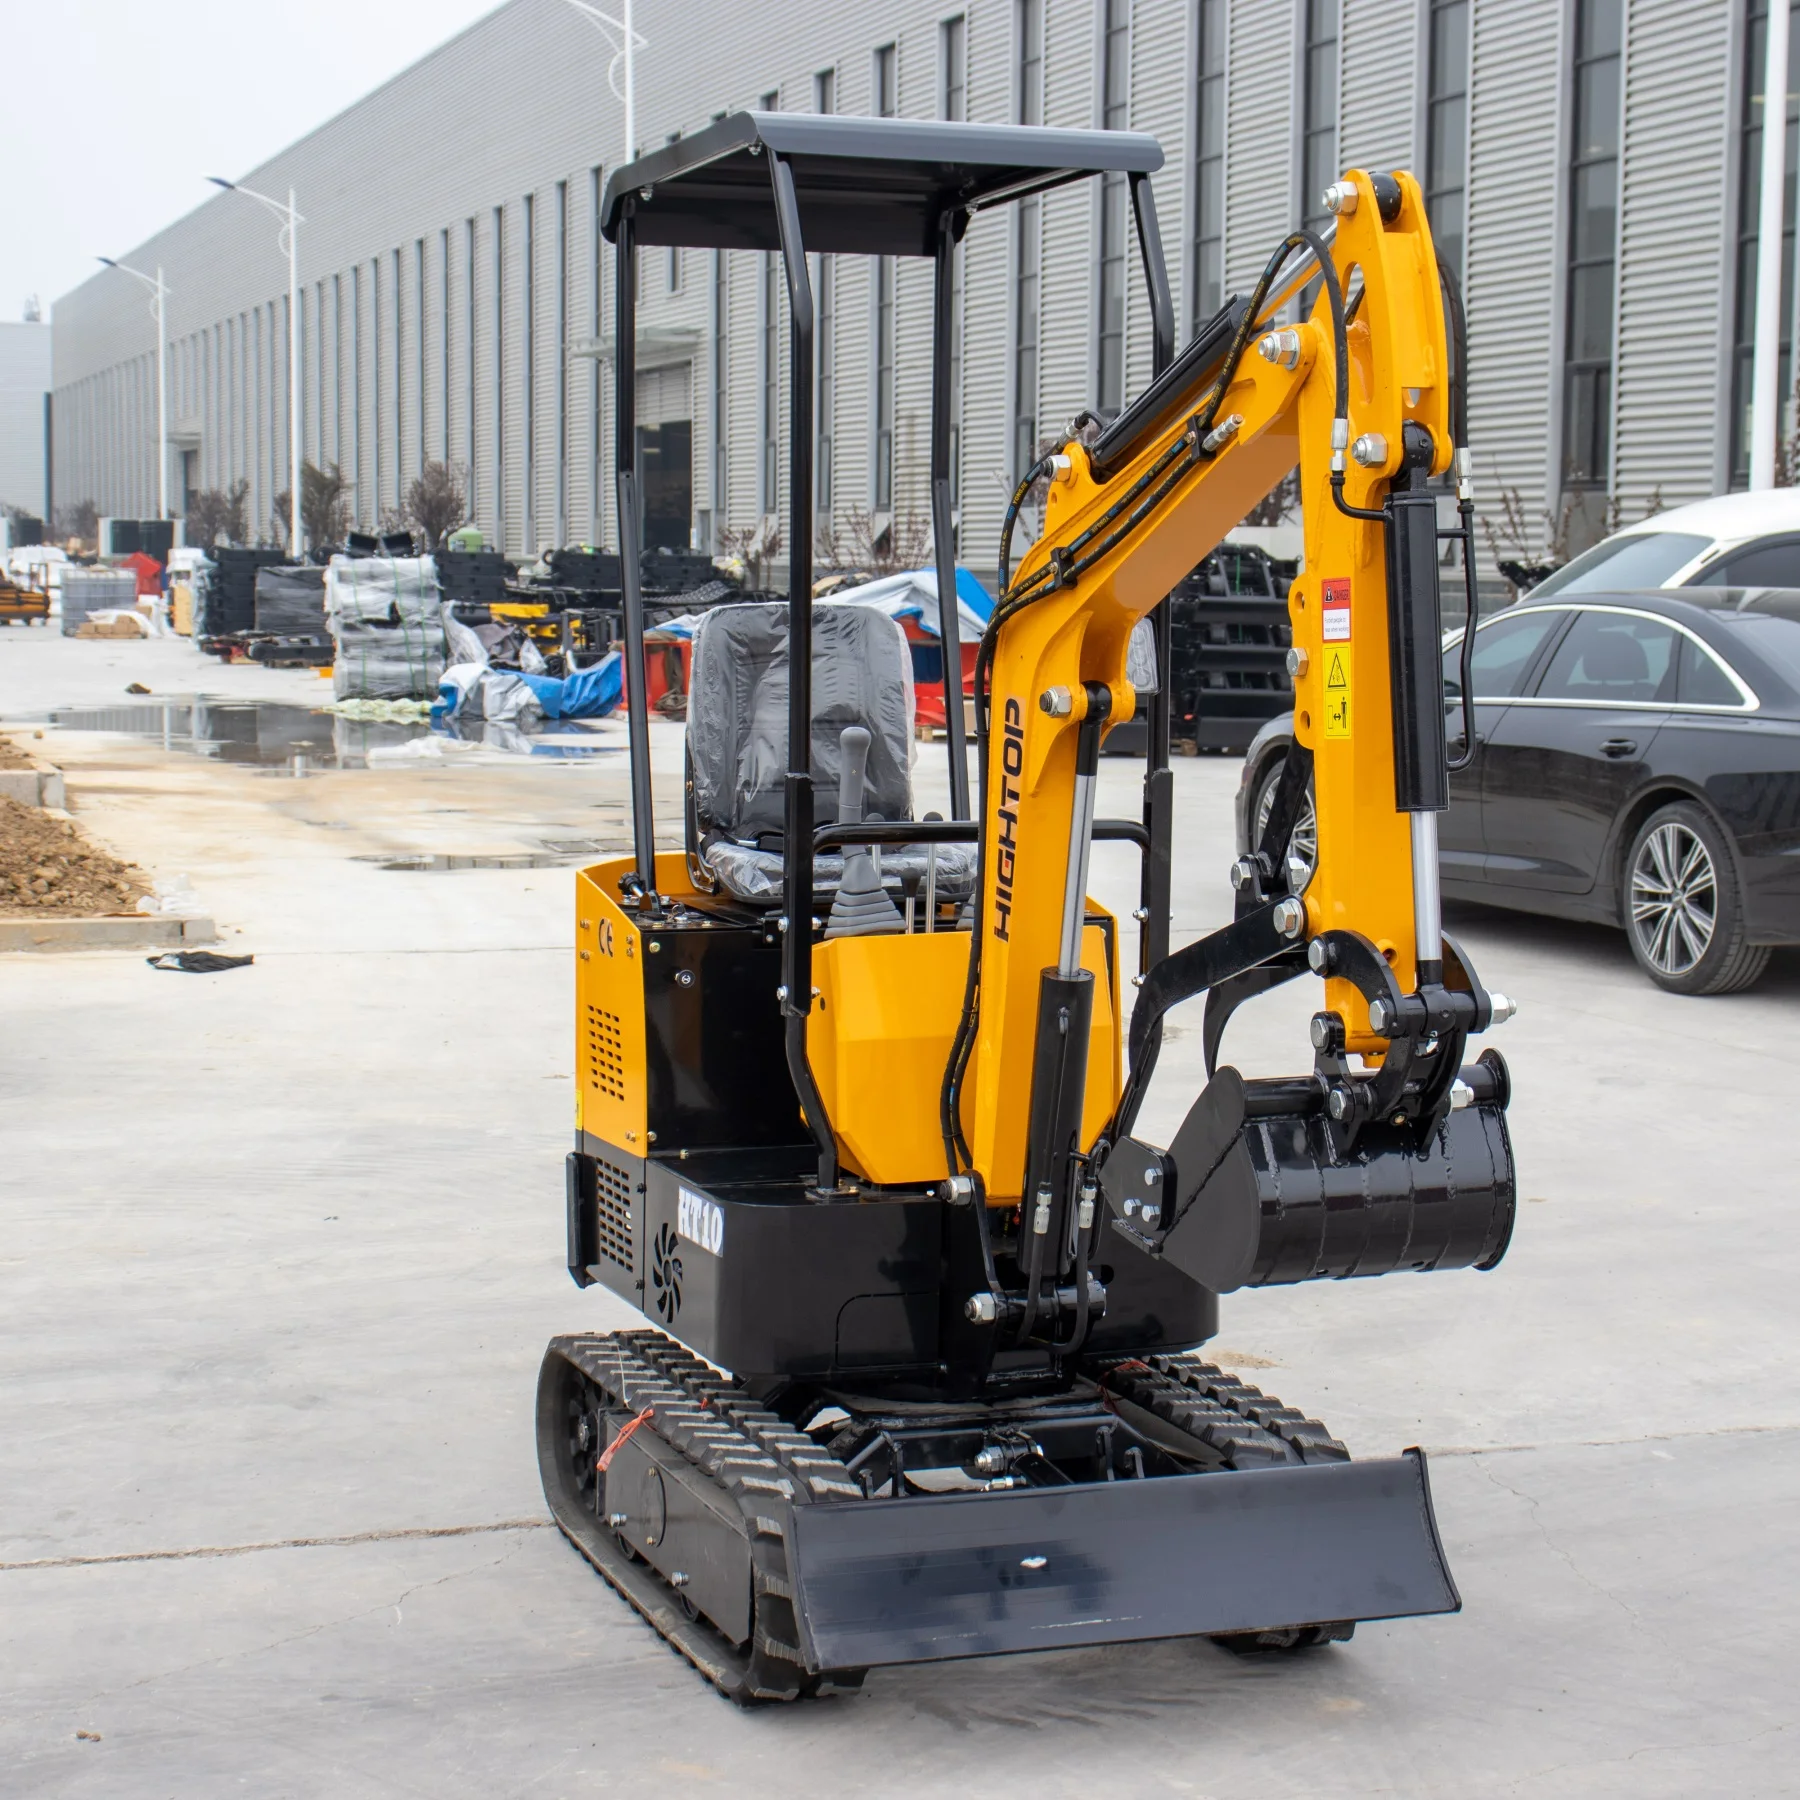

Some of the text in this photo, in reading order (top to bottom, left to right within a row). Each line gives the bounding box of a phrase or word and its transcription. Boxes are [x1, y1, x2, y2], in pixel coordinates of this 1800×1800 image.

[1012, 482, 1028, 506] YONGJIE
[994, 698, 1024, 943] HIGHTOP
[599, 919, 613, 957] CE
[678, 1187, 722, 1254] HT10
